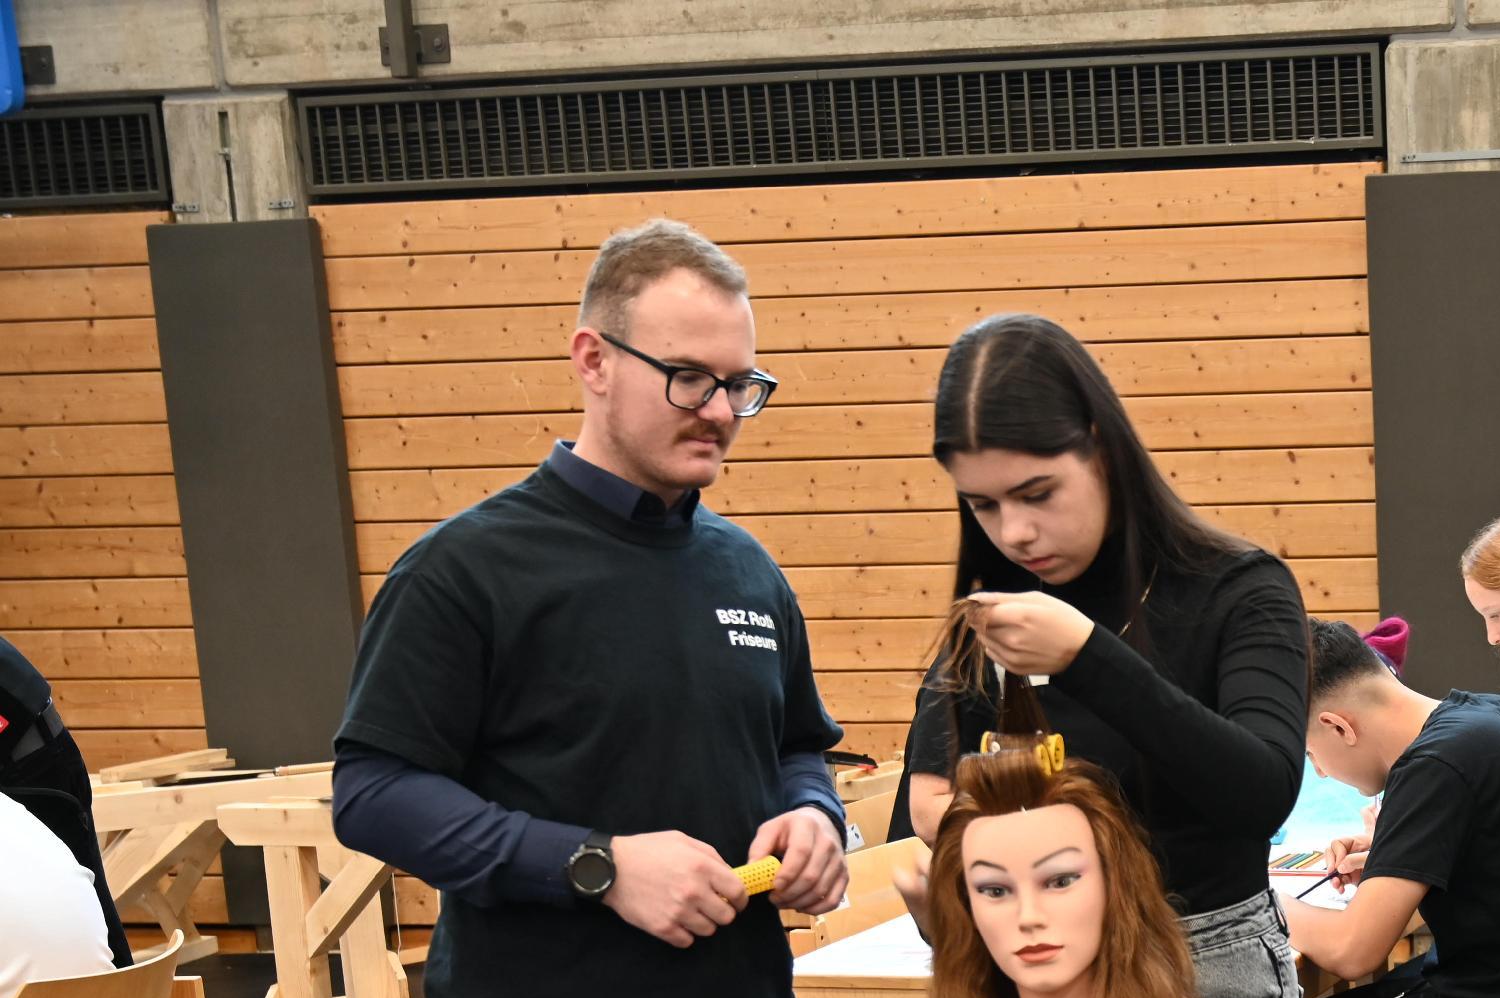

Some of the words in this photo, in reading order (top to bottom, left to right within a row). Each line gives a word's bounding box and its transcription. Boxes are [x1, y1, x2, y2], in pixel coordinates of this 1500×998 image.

[715, 608, 749, 625] BSZ
[748, 610, 776, 630] Roth
[728, 630, 778, 651] Friseure
